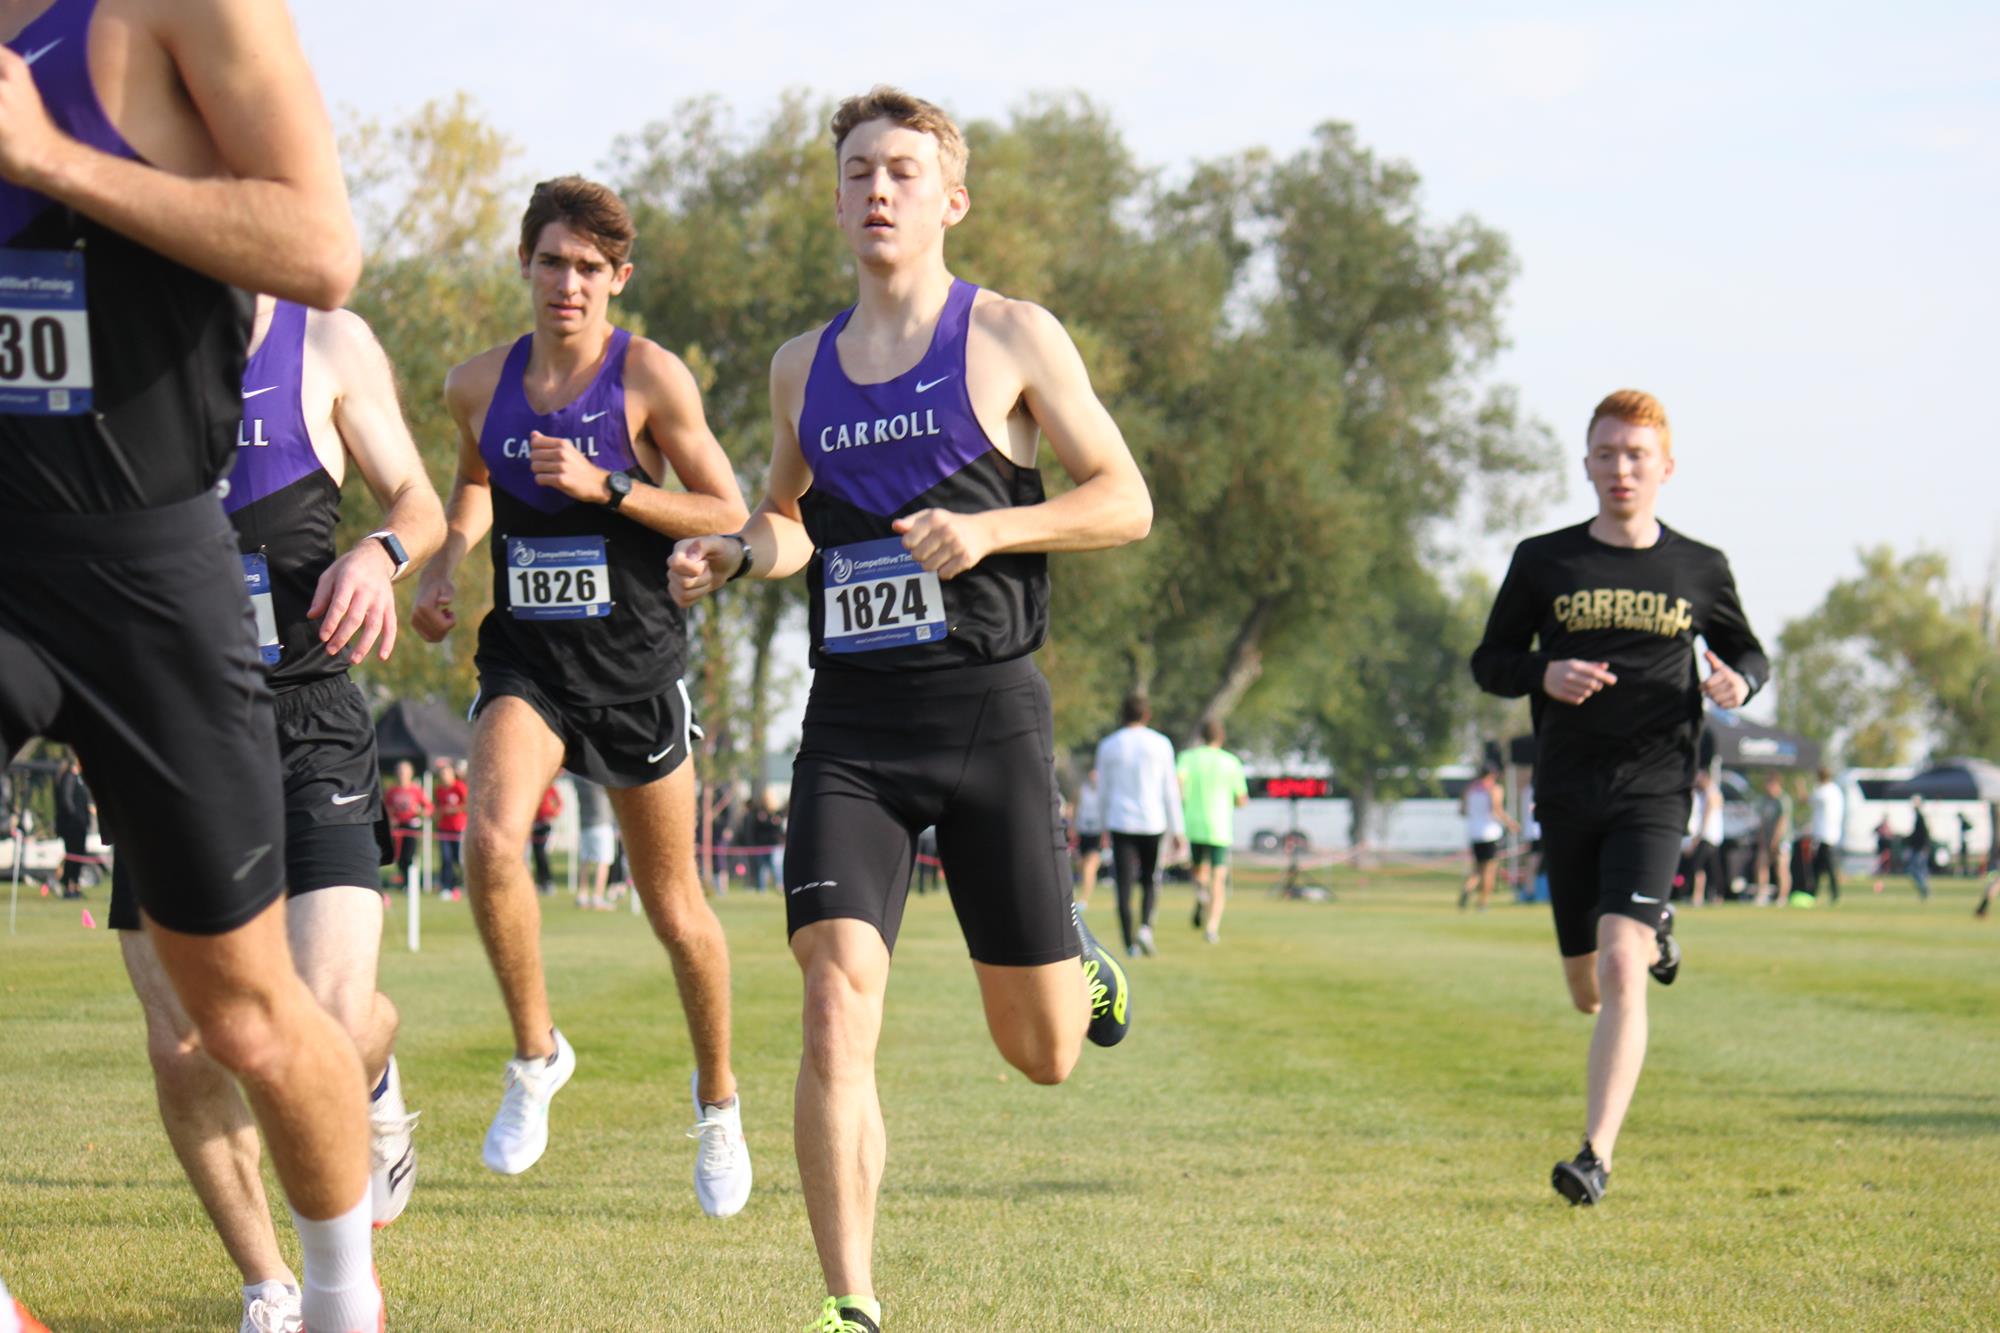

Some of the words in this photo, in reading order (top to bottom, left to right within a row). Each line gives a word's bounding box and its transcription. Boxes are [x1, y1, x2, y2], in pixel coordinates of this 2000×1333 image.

[820, 408, 941, 453] CARROLL
[517, 568, 596, 605] 1826
[836, 578, 927, 632] 1824
[1553, 588, 1692, 630] CARROLL
